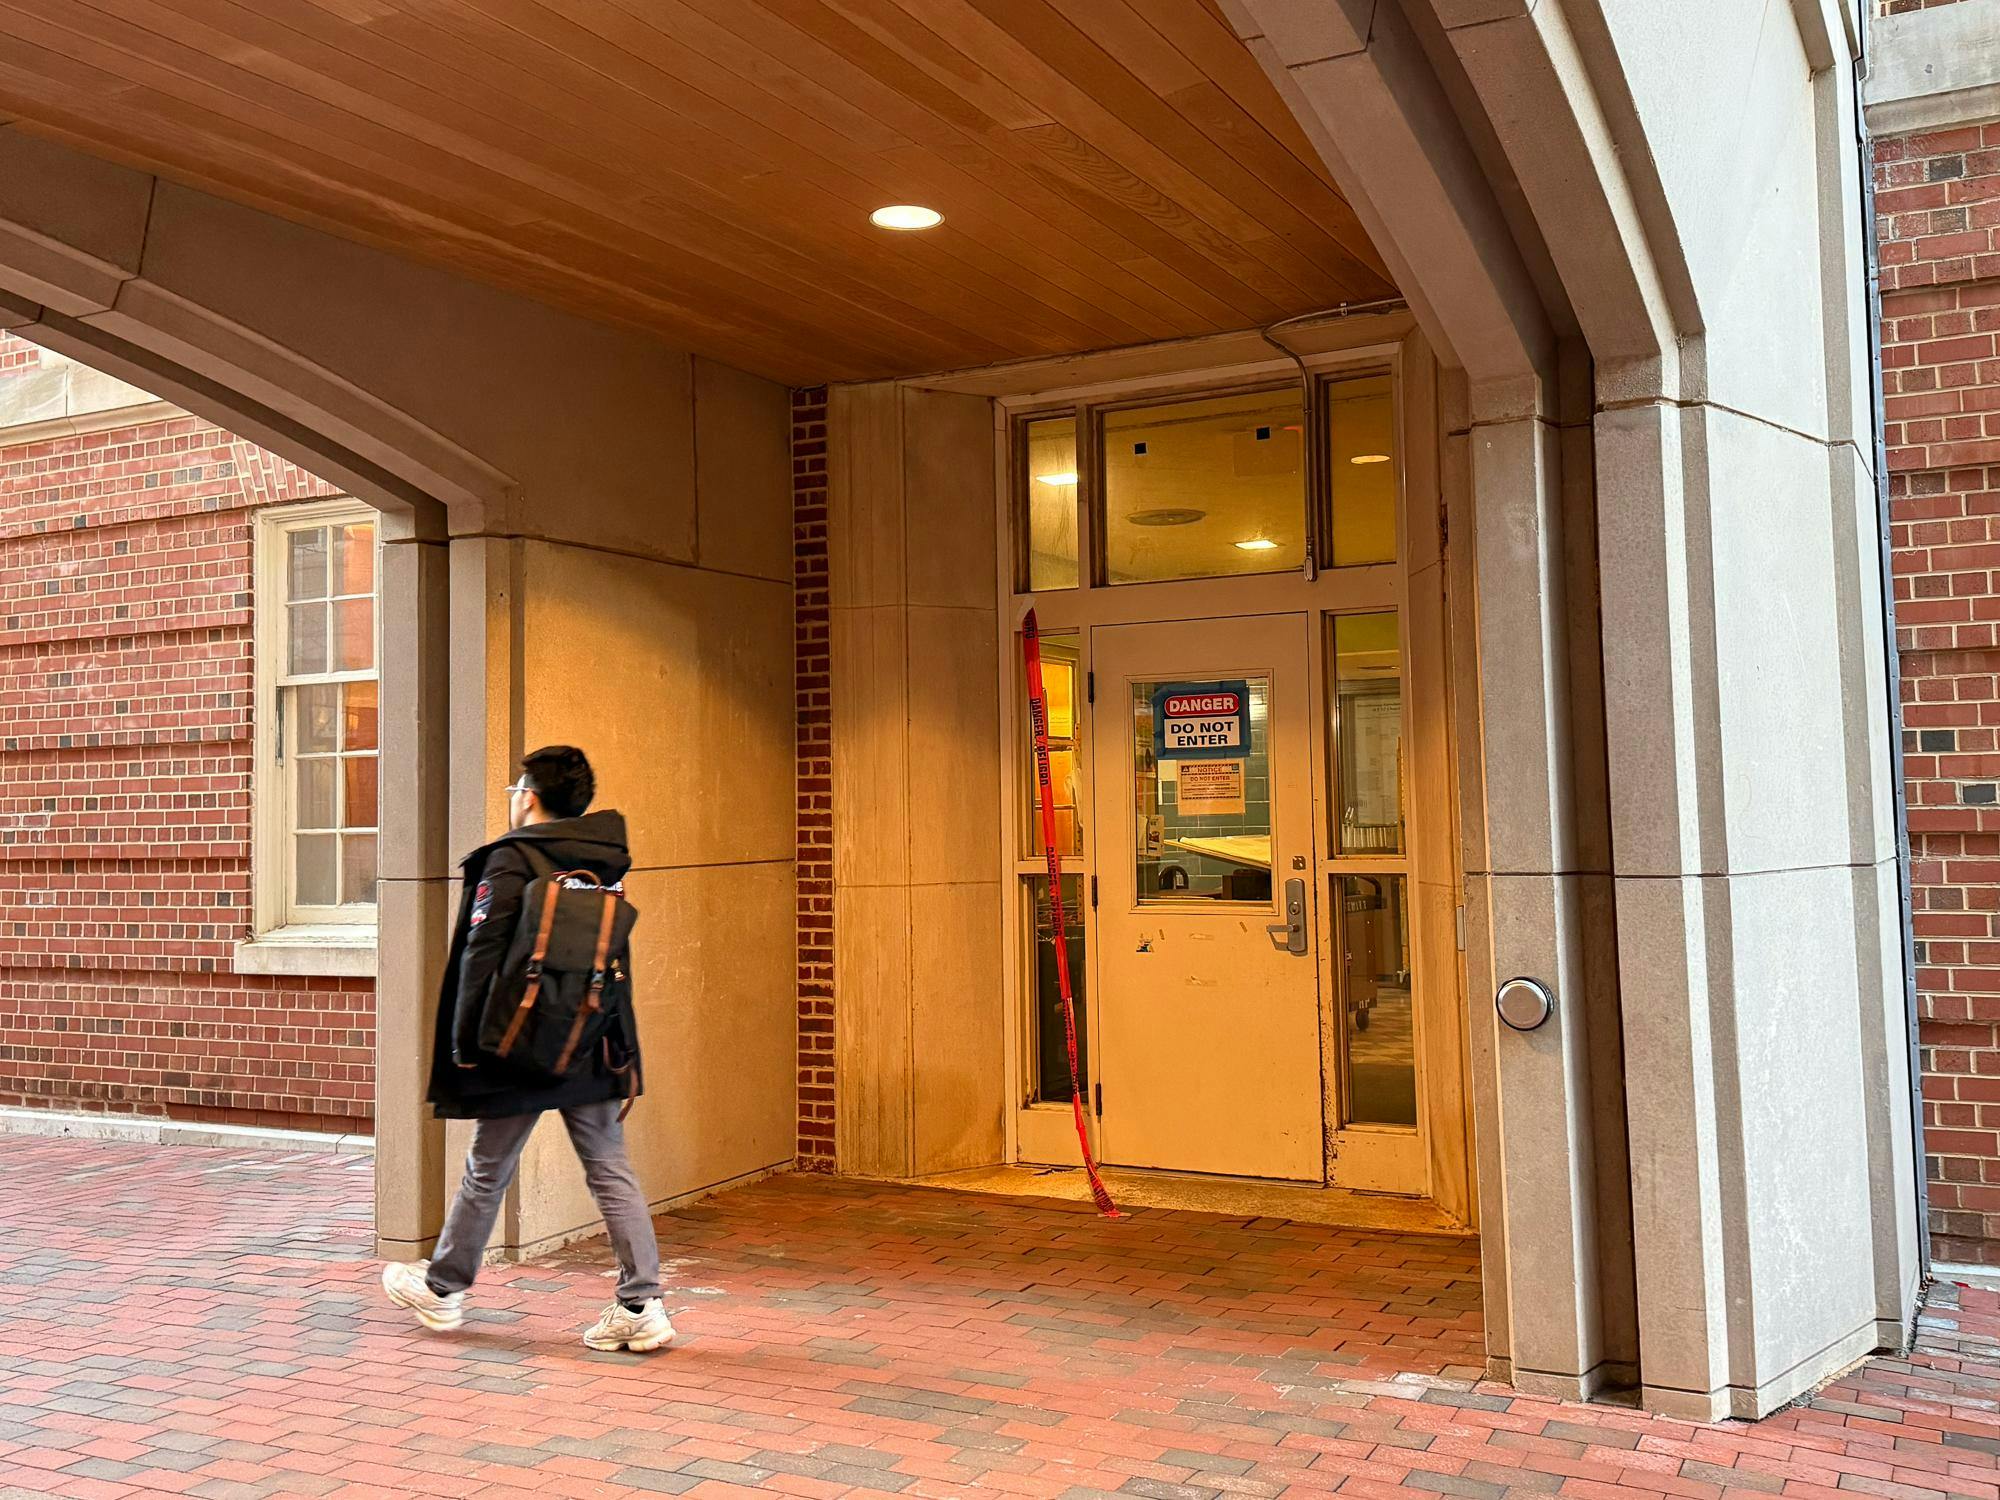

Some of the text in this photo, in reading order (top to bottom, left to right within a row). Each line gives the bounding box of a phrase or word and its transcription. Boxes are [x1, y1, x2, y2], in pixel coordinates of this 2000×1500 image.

[1169, 697, 1234, 713] DANGER
[1031, 698, 1044, 738] DANGER
[1171, 722, 1234, 734] DO NOT
[1177, 734, 1228, 746] ENTER
[1037, 746, 1049, 785] PELIGRO
